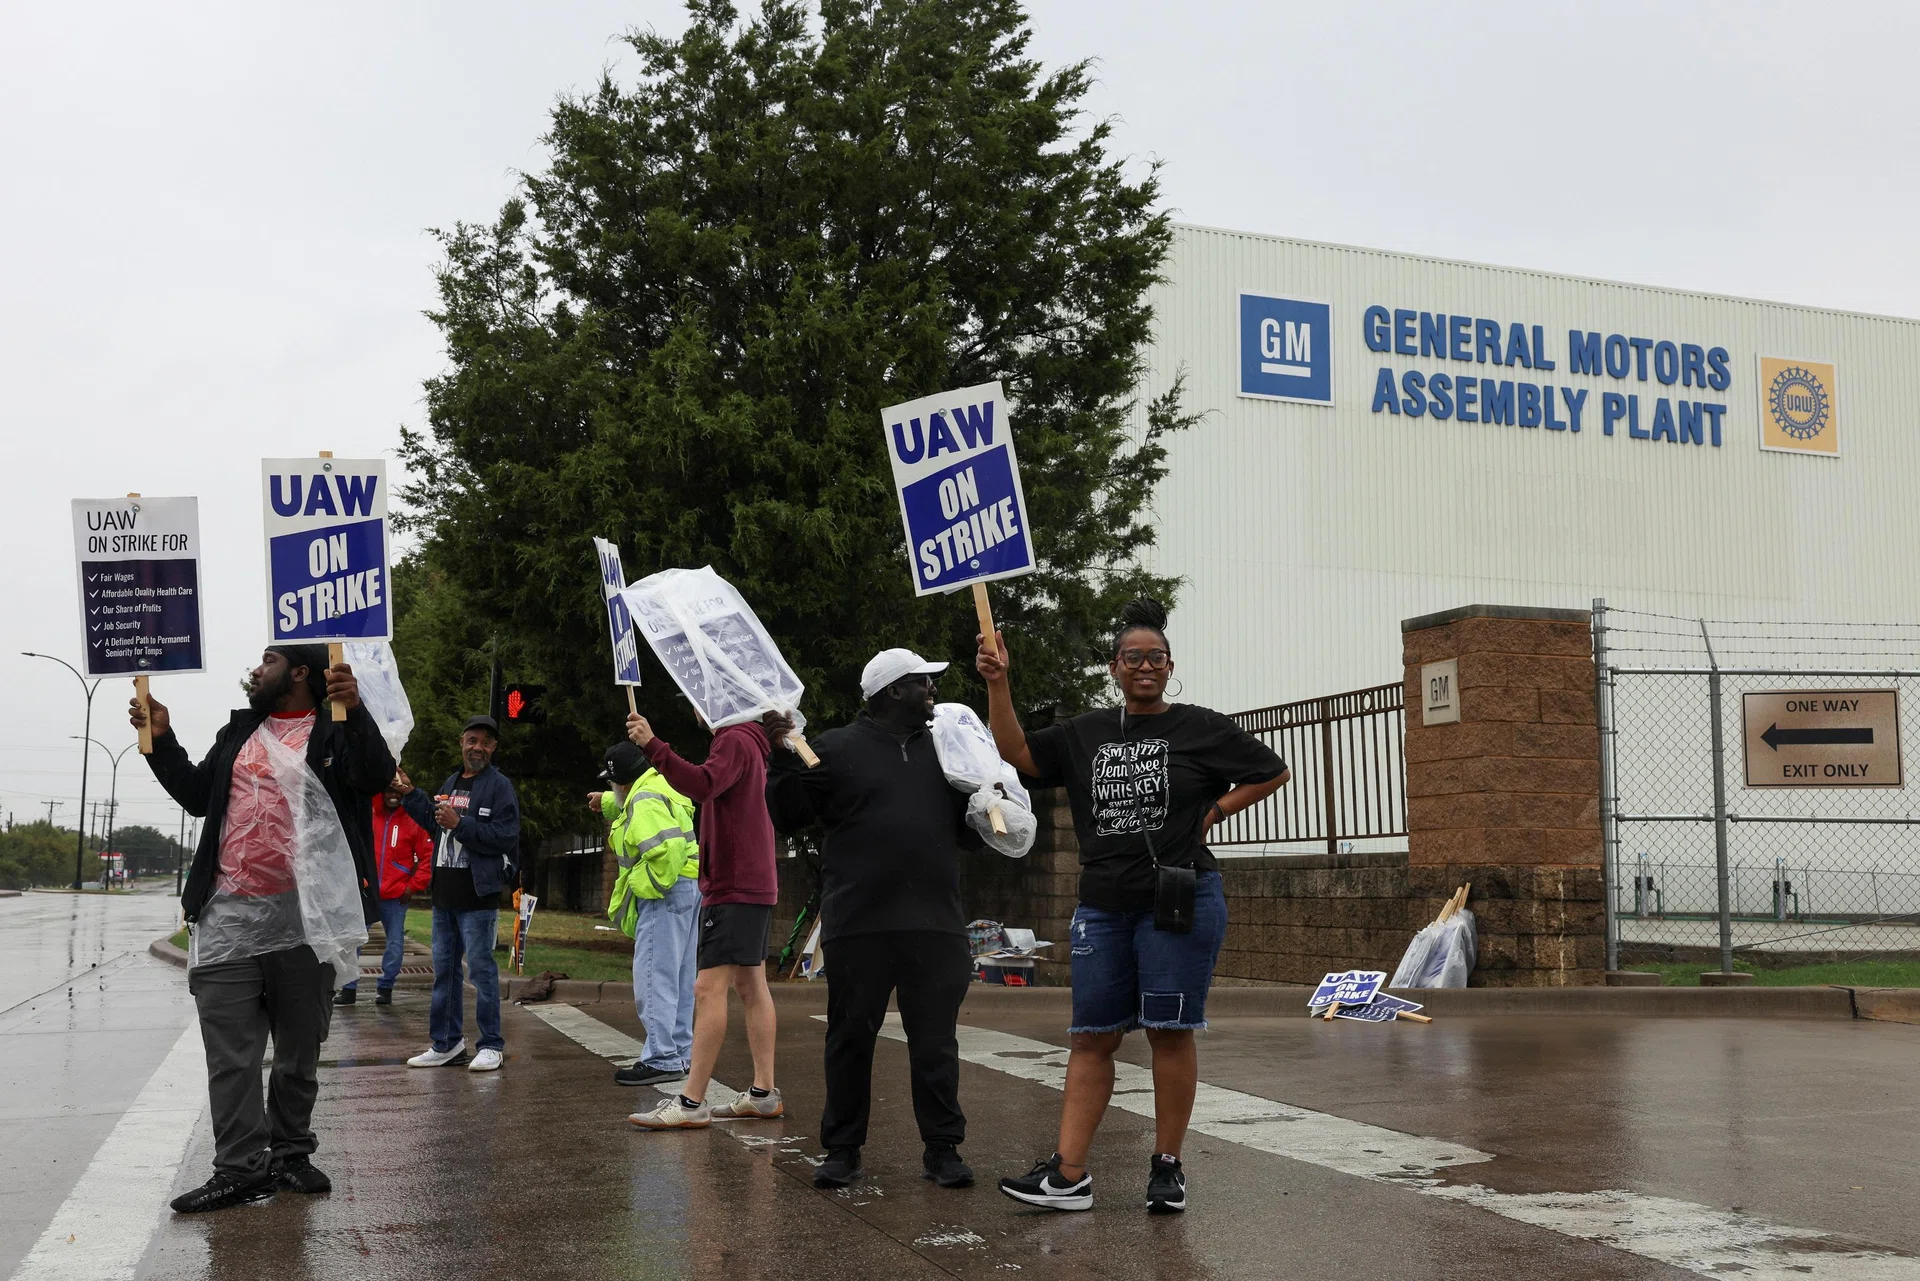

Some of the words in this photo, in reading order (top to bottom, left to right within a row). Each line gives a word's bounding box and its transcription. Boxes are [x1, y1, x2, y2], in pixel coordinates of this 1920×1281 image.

[1260, 317, 1311, 363] GM
[1363, 305, 1555, 371] GENERAL
[1569, 329, 1731, 391] MOTORS
[1371, 367, 1588, 432] ASSEMBLY
[1602, 391, 1727, 447] PLANT
[1786, 394, 1812, 412] UAW
[892, 400, 994, 465] UAW
[269, 474, 378, 517] UAW
[938, 466, 980, 521] ON
[87, 510, 136, 531] UAW
[88, 535, 107, 553] ON
[112, 534, 158, 552] STRIKE
[162, 533, 188, 551] FOR
[919, 495, 1019, 581] STRIKE
[308, 532, 349, 578] ON
[100, 573, 112, 582] Fair
[114, 572, 134, 583] Wages
[101, 588, 133, 598] Affordable
[134, 587, 156, 597] Quality
[157, 587, 177, 596] Health
[178, 586, 193, 595] Care
[278, 567, 381, 633] STRIKE
[102, 605, 115, 615] Our
[115, 604, 133, 614] Share
[134, 604, 141, 613] of
[142, 603, 162, 613] Profits
[103, 621, 114, 631] Job
[115, 620, 141, 630] Security
[104, 638, 110, 647] A
[111, 637, 134, 646] Defined
[135, 636, 149, 645] Path
[149, 636, 156, 645] to
[157, 635, 191, 645] Permanent
[105, 648, 133, 658] Seniority
[134, 648, 144, 656] for
[144, 646, 163, 657] Temps
[1430, 675, 1449, 702] GM
[1786, 700, 1818, 712] ONE
[1822, 700, 1859, 712] WAY
[1783, 764, 1818, 777] EXIT
[1823, 764, 1869, 777] ONLY
[1097, 776, 1161, 800] WHISKEY
[1108, 797, 1140, 808] SWEE
[1143, 795, 1155, 803] AS
[1326, 972, 1380, 983] UAW
[1314, 989, 1371, 1004] STRIKE
[1335, 983, 1358, 992] ON
